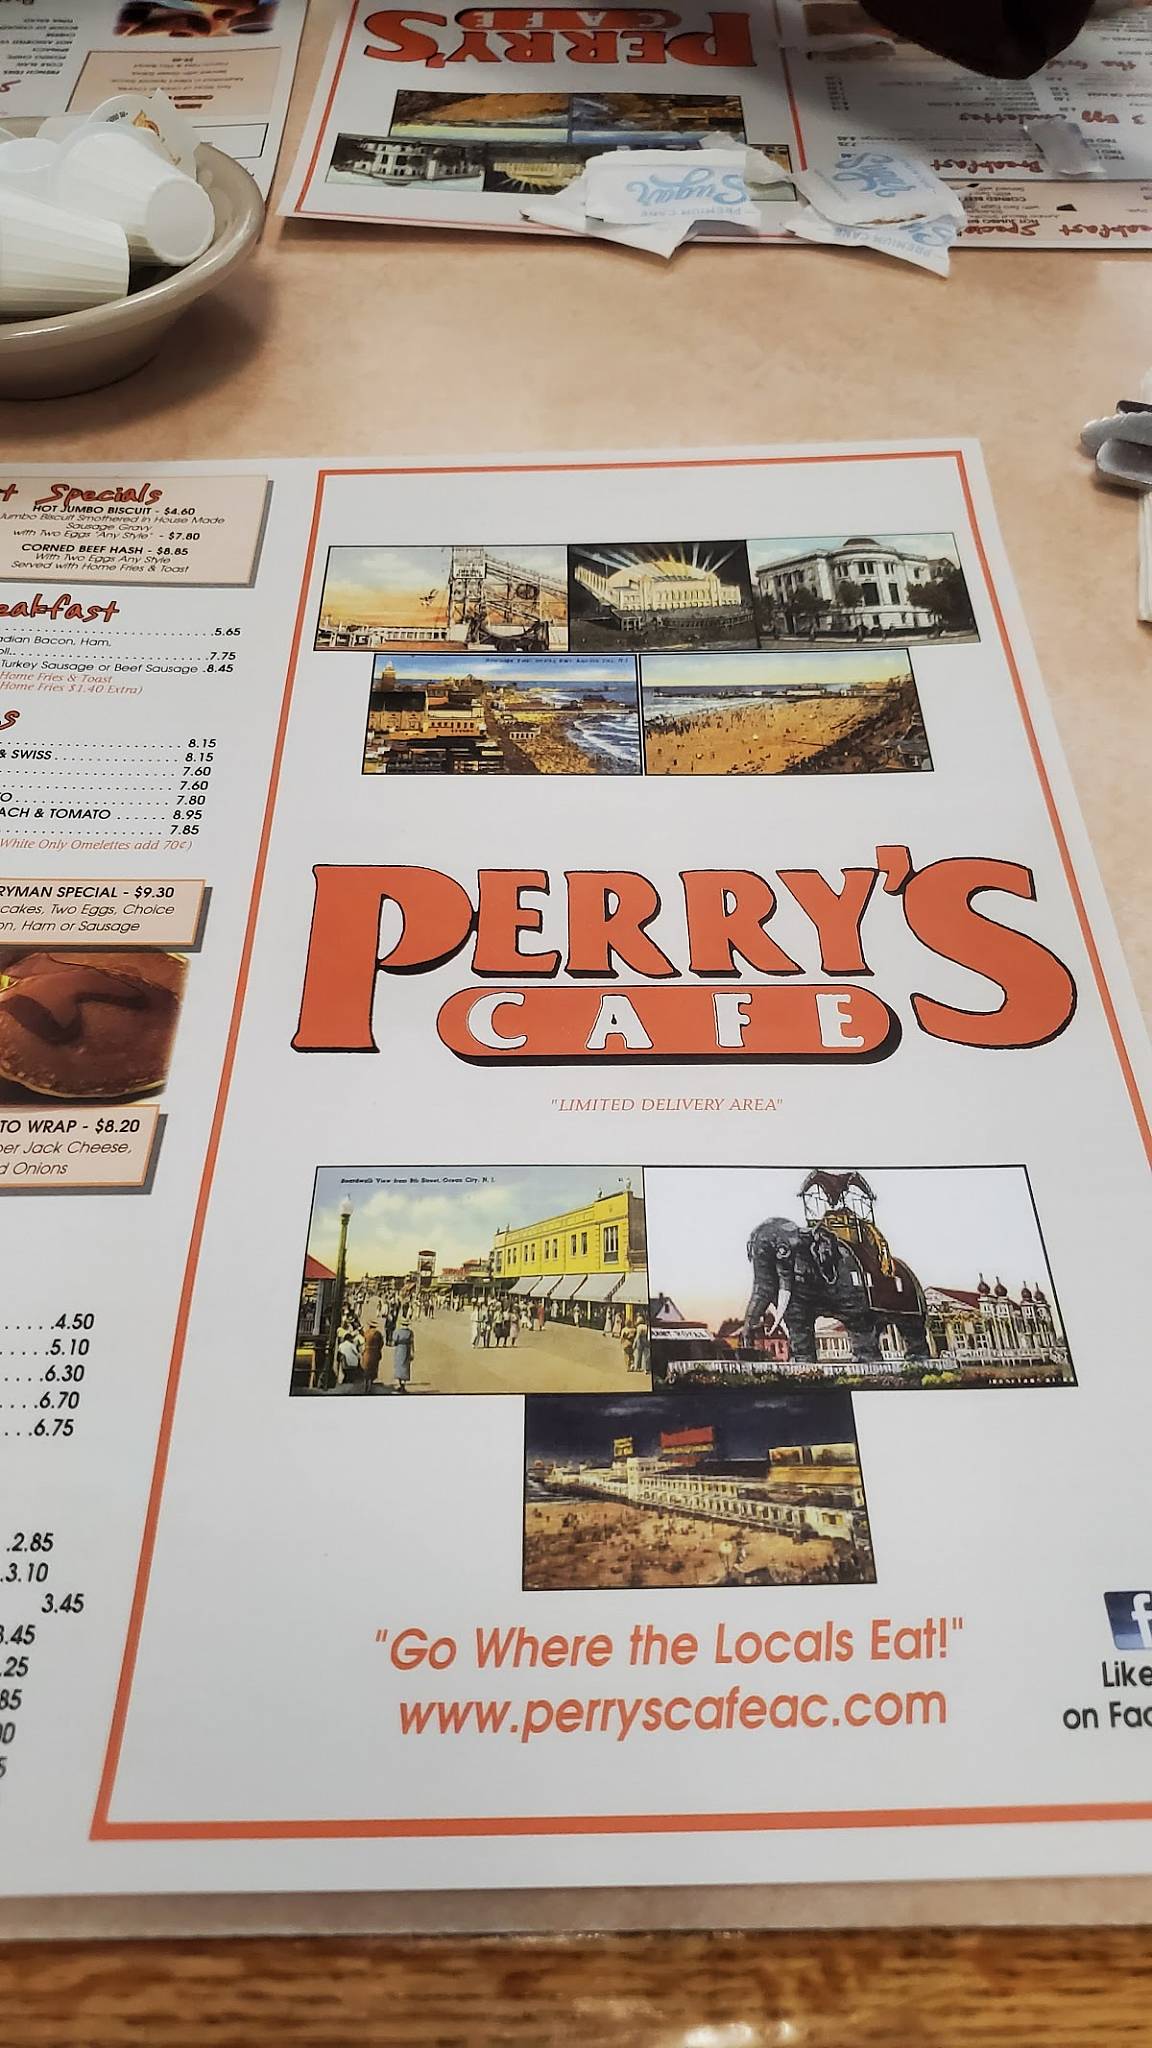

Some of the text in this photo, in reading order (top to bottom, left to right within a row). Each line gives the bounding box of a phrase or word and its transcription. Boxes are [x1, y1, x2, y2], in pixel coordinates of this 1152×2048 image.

[472, 11, 668, 28] CAFE
[363, 10, 757, 68] PERRY'S
[930, 159, 1043, 174] Breakfast
[626, 167, 748, 206] Sugar
[35, 483, 163, 507] Specials
[33, 505, 196, 516] HOT JUMBO BISCUIT $4.60
[40, 513, 75, 521] Biscuit
[77, 514, 140, 523] Smothered
[154, 516, 189, 524] House
[191, 516, 226, 524] Made
[66, 522, 153, 533] Sausage Gravy
[13, 529, 37, 537] with
[64, 531, 92, 539] Eggs
[168, 532, 201, 541] $7.80
[21, 543, 189, 556] CORNED BEEF HASH $8.85
[36, 553, 171, 564] With Two Eggs Any Style
[11, 560, 54, 569] Served
[55, 562, 79, 570] with
[81, 562, 117, 572] Home
[120, 563, 145, 572] Fries
[34, 636, 76, 646] Bacon,
[80, 638, 112, 647] Ham,
[1, 660, 38, 670] Turkey
[41, 661, 94, 673] Sausage
[114, 663, 143, 672] Beef
[145, 664, 199, 675] Sausage
[0, 671, 113, 684] Home Fries & Toast
[0, 681, 143, 696] Home Fries $1.40 Extra)
[188, 739, 217, 748] 8.15
[11, 749, 52, 760] SWISS
[185, 752, 214, 762] 8.15
[182, 766, 211, 776] 7.60
[180, 780, 209, 790] 7.60
[176, 795, 206, 805] 7.80
[34, 808, 44, 818] &
[50, 808, 111, 820] TOMATO
[173, 809, 202, 820] 8.95
[170, 824, 199, 835] 7.85
[0, 838, 35, 849] White
[38, 839, 67, 852] Only
[71, 840, 130, 850] Omelettes
[134, 840, 160, 850] add
[56, 886, 118, 898] SPECIAL
[134, 885, 175, 899] $9.30
[50, 903, 77, 915] Two
[81, 903, 118, 918] Eggs,
[123, 904, 175, 915] Choice
[21, 920, 56, 931] Ham
[59, 923, 76, 931] or
[78, 920, 141, 934] Sausage
[289, 844, 1078, 1054] PERRY'S
[466, 991, 866, 1050] CAFE
[551, 1098, 783, 1112] "LIMITED DELIVERY AREA"
[28, 1119, 77, 1133] WRAP
[95, 1118, 140, 1134] $8.20
[23, 1141, 63, 1154] Jack
[67, 1140, 132, 1155] Cheese,
[13, 1161, 69, 1175] Onions
[41, 1593, 85, 1613] 3.45
[375, 1617, 964, 1670] "Go Where the Locals Eat!"
[400, 1686, 947, 1743] www.perryscafeac.com
[1063, 1708, 1099, 1730] on
